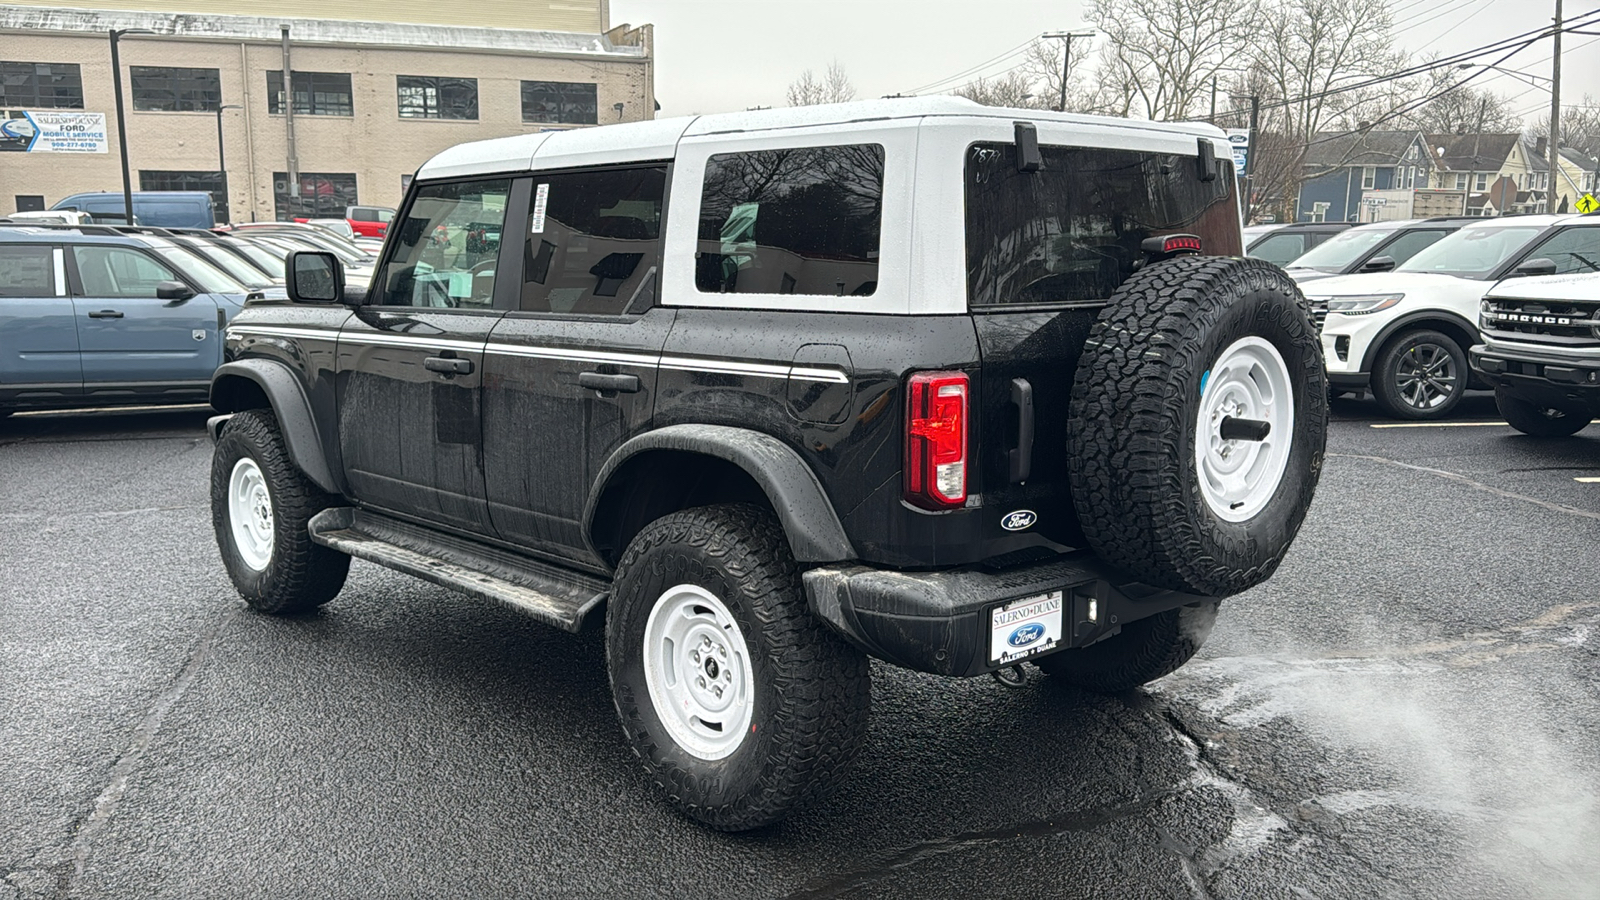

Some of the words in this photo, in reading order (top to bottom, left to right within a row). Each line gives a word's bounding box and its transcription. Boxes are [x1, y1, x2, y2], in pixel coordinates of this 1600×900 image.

[1498, 313, 1570, 325] BRONCO
[1008, 513, 1031, 528] Ford
[994, 608, 1030, 627] SALERNO
[1033, 599, 1061, 615] DUANE
[1014, 627, 1039, 645] Ford
[1000, 650, 1029, 665] SALERNO
[1036, 641, 1057, 653] DUANE
